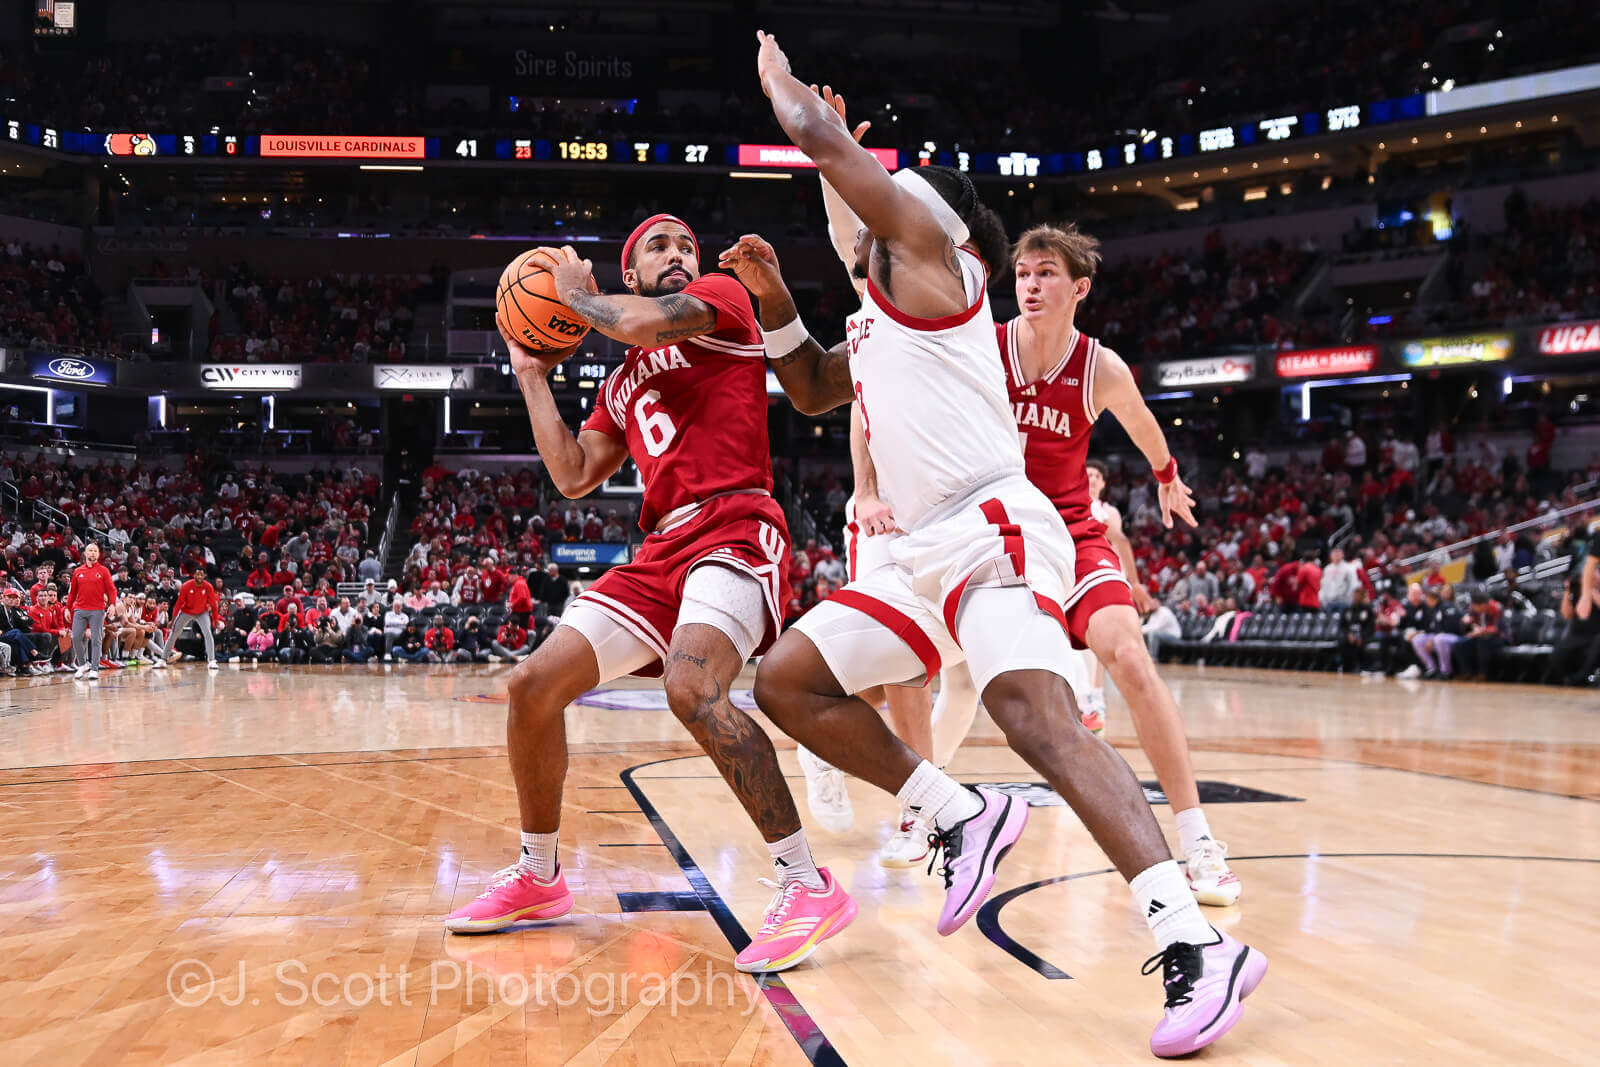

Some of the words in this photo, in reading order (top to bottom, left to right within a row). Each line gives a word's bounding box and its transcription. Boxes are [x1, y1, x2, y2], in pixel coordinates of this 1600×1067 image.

[514, 49, 557, 77] Sire
[564, 50, 633, 81] Spirits
[43, 134, 58, 149] 21
[226, 142, 236, 154] 0
[269, 140, 341, 152] LOUISVILLE
[344, 141, 417, 153] CARDINALS
[456, 140, 477, 157] 41
[515, 146, 532, 160] 23
[559, 142, 608, 160] 19:53
[684, 145, 709, 163] 27
[57, 360, 87, 376] Ford
[272, 369, 300, 377] WIDE
[613, 344, 692, 423] NDIANA
[634, 388, 677, 458] 6
[1009, 401, 1072, 438] IANA
